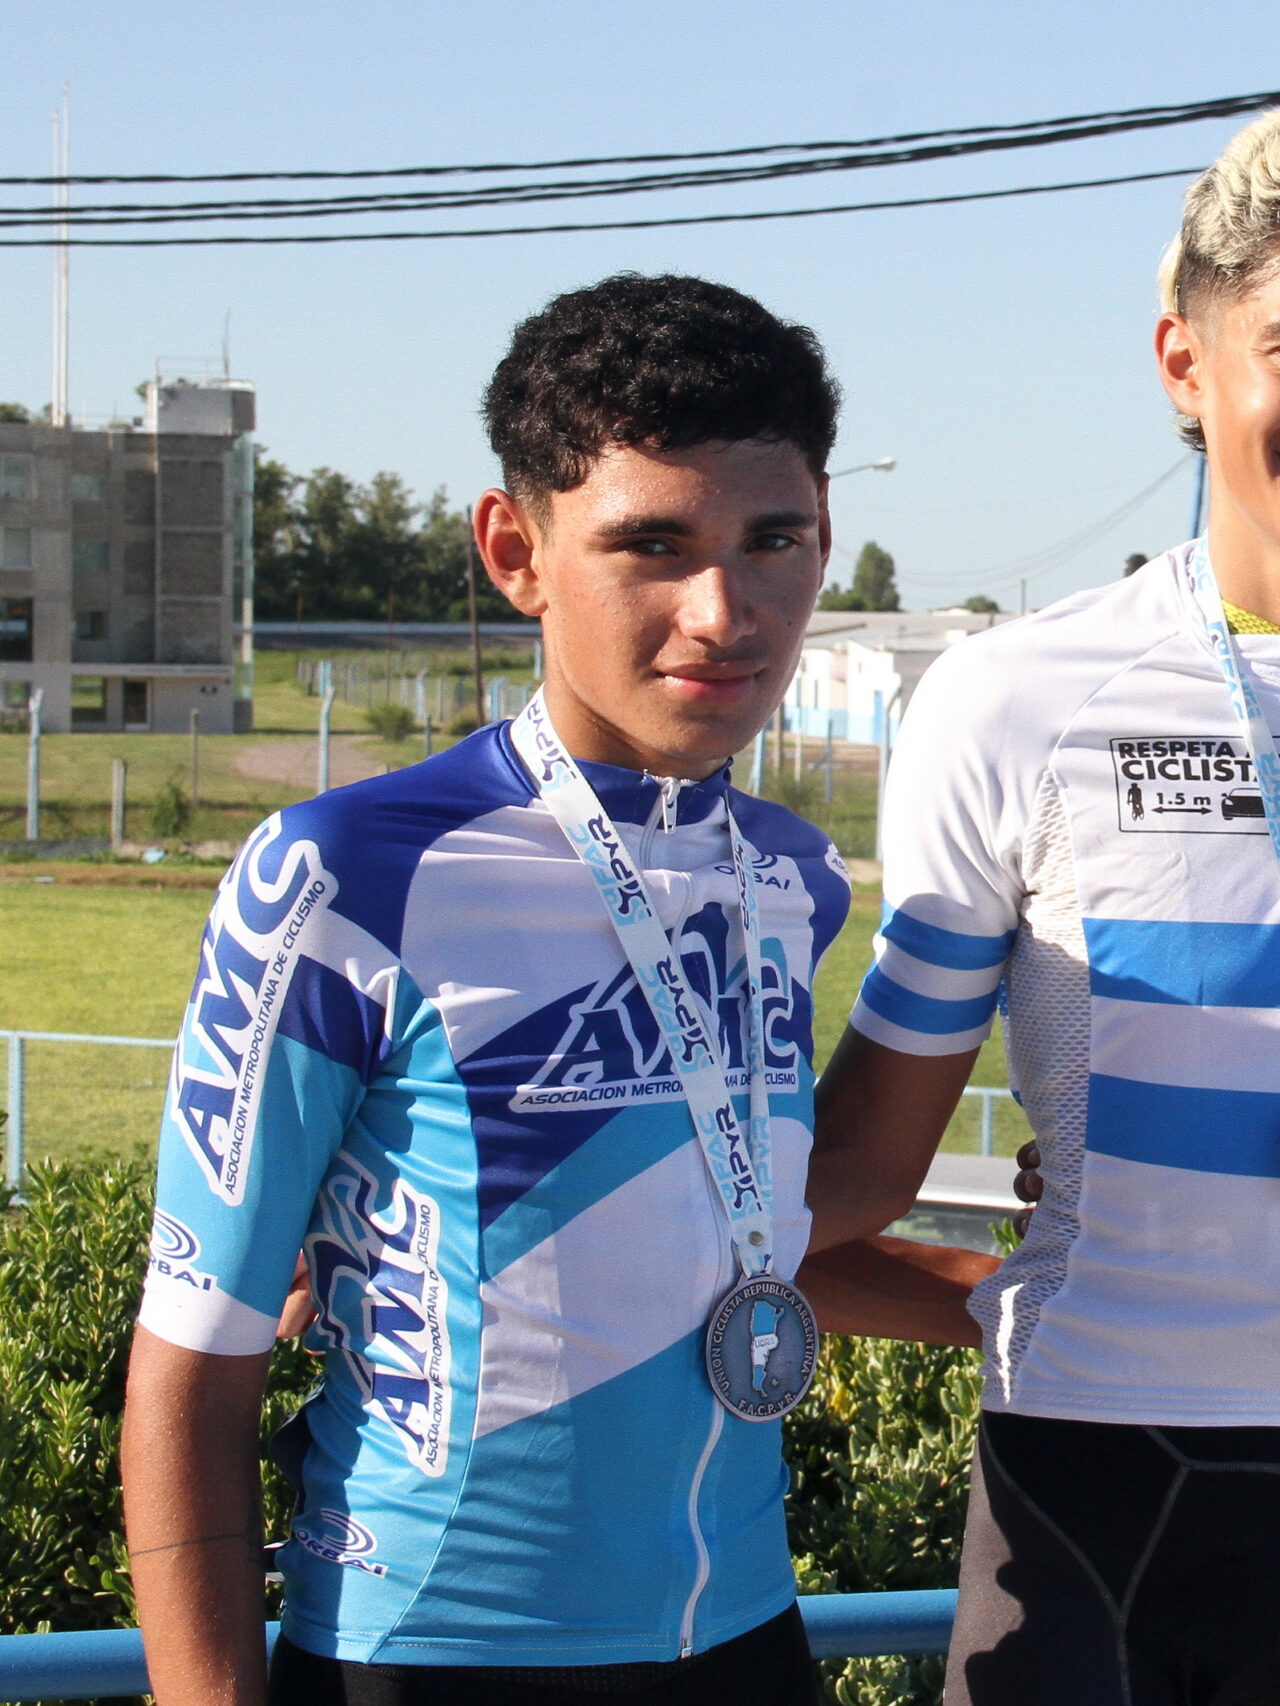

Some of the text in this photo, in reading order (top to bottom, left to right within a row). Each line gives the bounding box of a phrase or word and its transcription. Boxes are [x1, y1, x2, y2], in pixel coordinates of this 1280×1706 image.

[1118, 741, 1236, 759] RESPETA
[1121, 759, 1258, 782] CICLIST
[1157, 793, 1211, 806] 1.5 m
[714, 865, 790, 890] OBAI
[225, 880, 325, 1195] ASOCIACION METROPOLITANA DE CICLISMO
[520, 1086, 626, 1105] ASOCIACION
[765, 1073, 796, 1085] CLISMO
[150, 1255, 211, 1291] RBAI
[713, 1293, 744, 1344] CICLISTA
[743, 1283, 796, 1304] REPUBLICA
[297, 1530, 383, 1575] ORBAI
